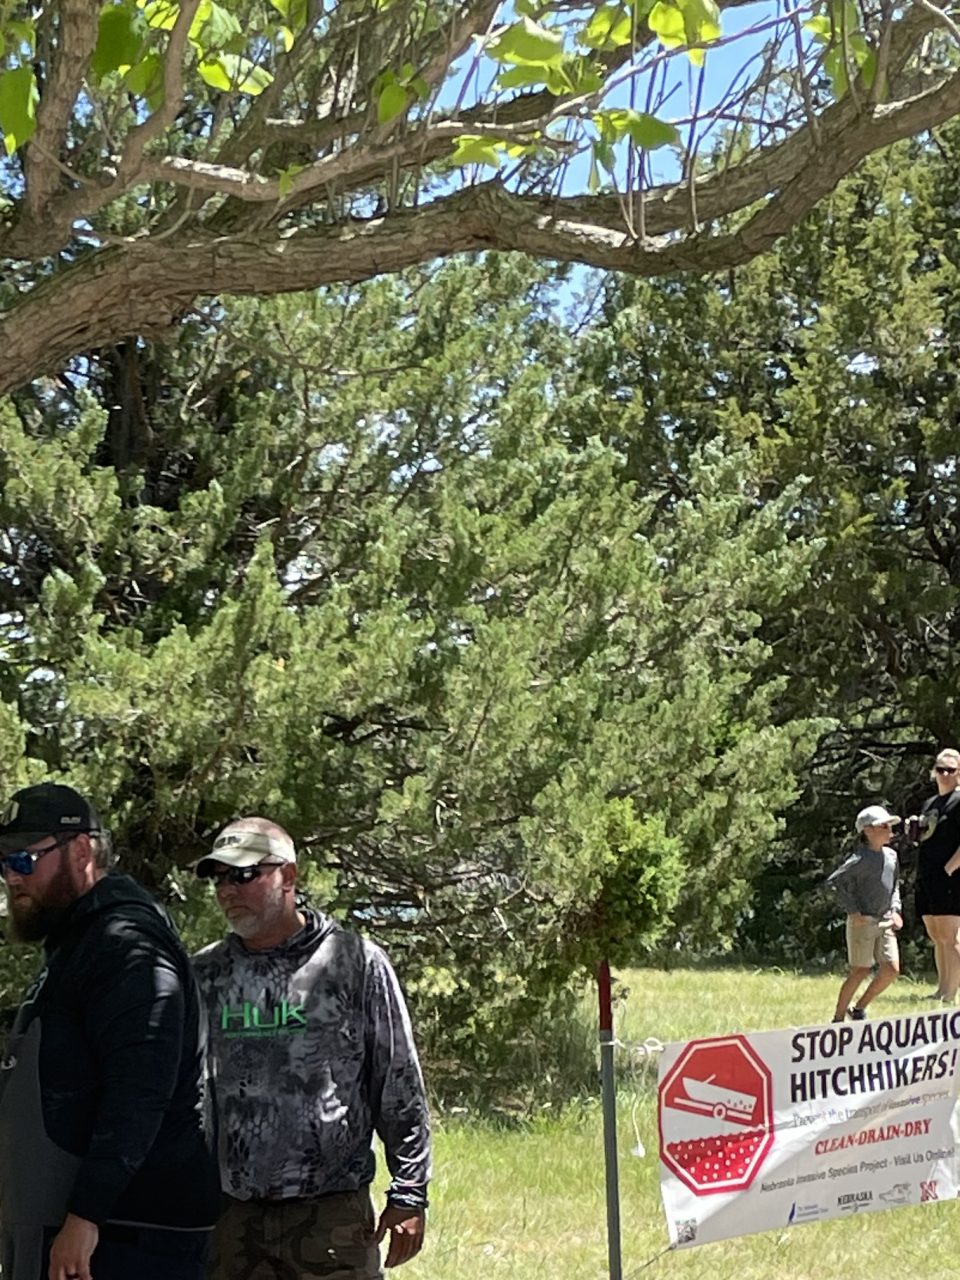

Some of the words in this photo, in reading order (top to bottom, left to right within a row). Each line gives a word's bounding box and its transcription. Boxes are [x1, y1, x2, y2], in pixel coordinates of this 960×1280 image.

[791, 1027, 854, 1063] STOP
[858, 1010, 960, 1055] AQUATIC
[790, 1048, 958, 1103] HITCHHIKERS!
[814, 1118, 933, 1156] CLEAN-DRAIN-DRY
[860, 1159, 888, 1173] Project
